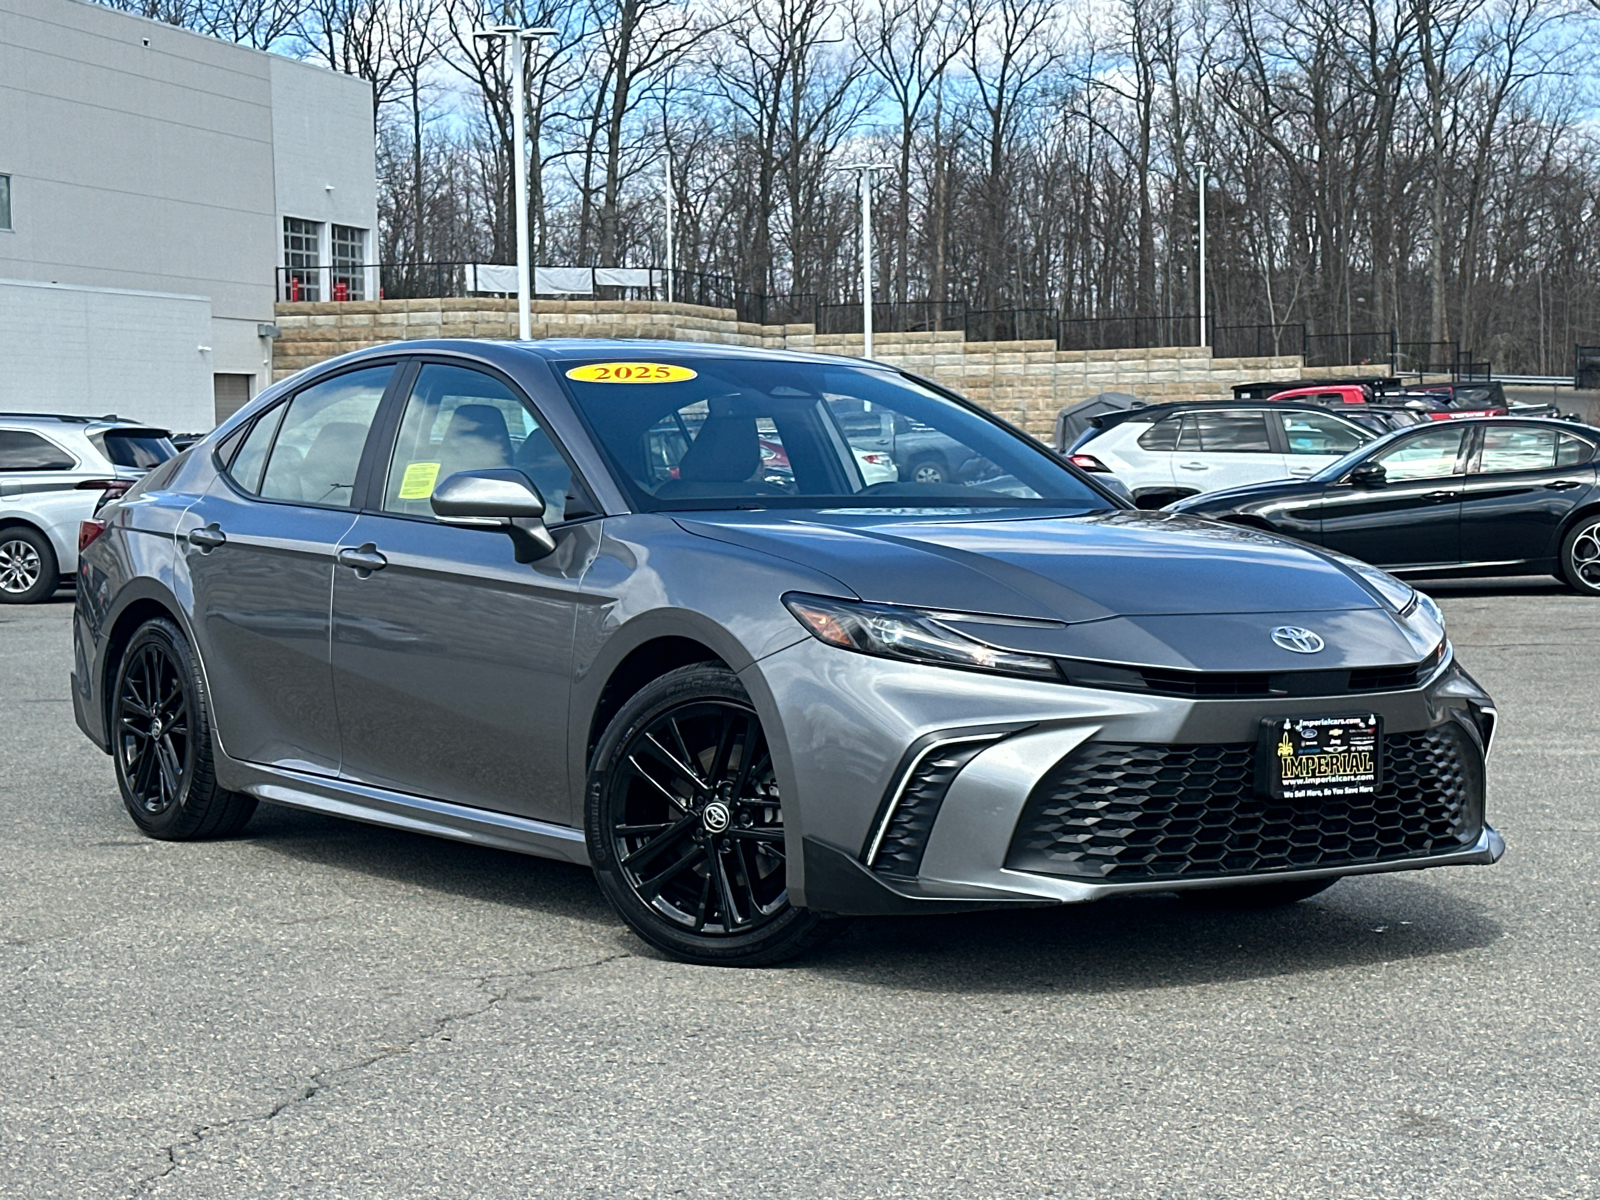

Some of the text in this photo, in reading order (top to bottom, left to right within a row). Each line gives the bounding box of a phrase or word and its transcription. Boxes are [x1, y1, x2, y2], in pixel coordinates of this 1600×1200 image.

[594, 366, 671, 380] 2025
[1281, 752, 1374, 778] IMPERIAL
[1284, 790, 1293, 798] We
